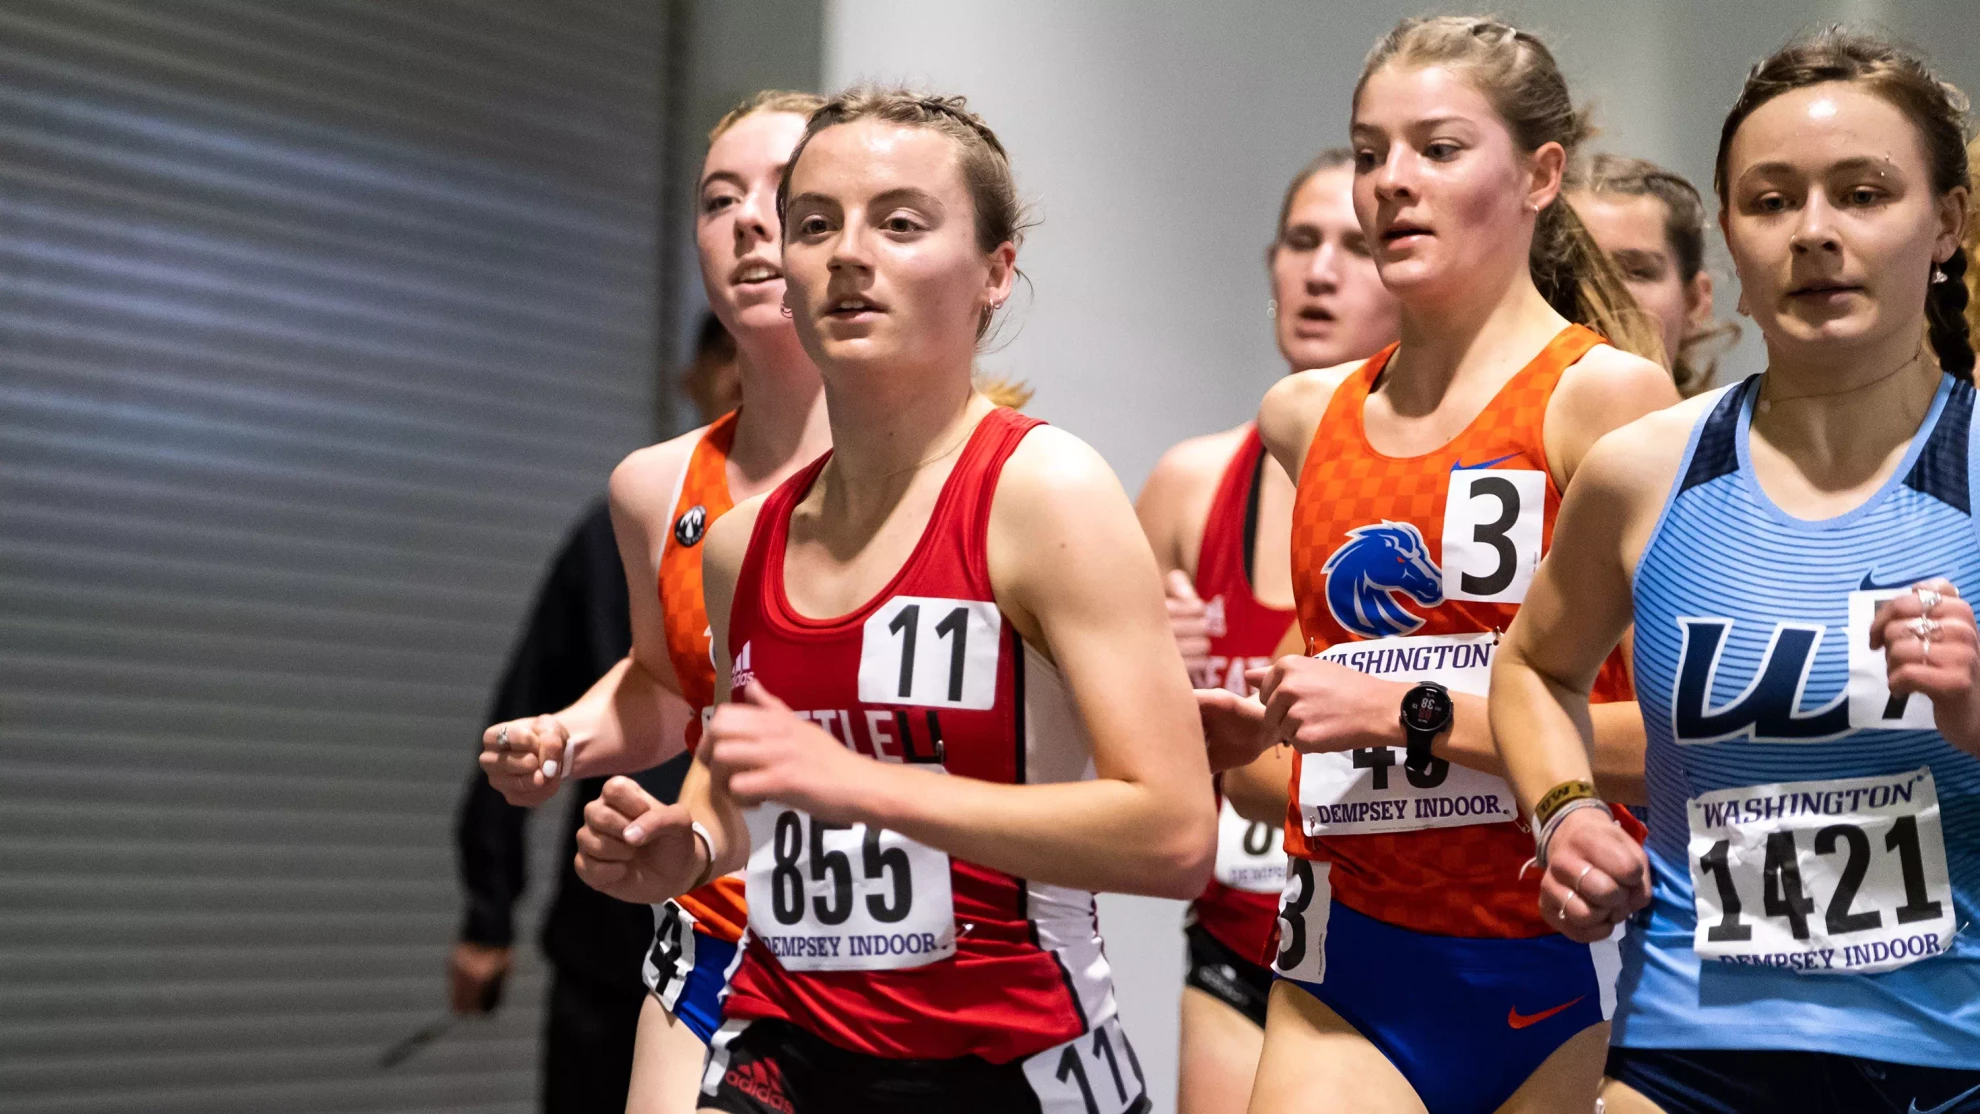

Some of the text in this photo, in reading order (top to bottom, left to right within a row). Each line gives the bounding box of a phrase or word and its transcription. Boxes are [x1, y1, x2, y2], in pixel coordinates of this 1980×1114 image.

[1460, 476, 1521, 596] 3
[888, 604, 969, 702] 11
[1317, 794, 1501, 824] DEMPSEY INDOOR
[1703, 779, 1915, 829] WASHINGTON
[772, 811, 912, 926] 855
[1700, 815, 1943, 943] 1421
[762, 933, 937, 957] DEMPSEY INDOOR
[1845, 933, 1941, 968] INDOOR
[725, 1070, 796, 1114] adidas
[1055, 1025, 1129, 1114] 11
